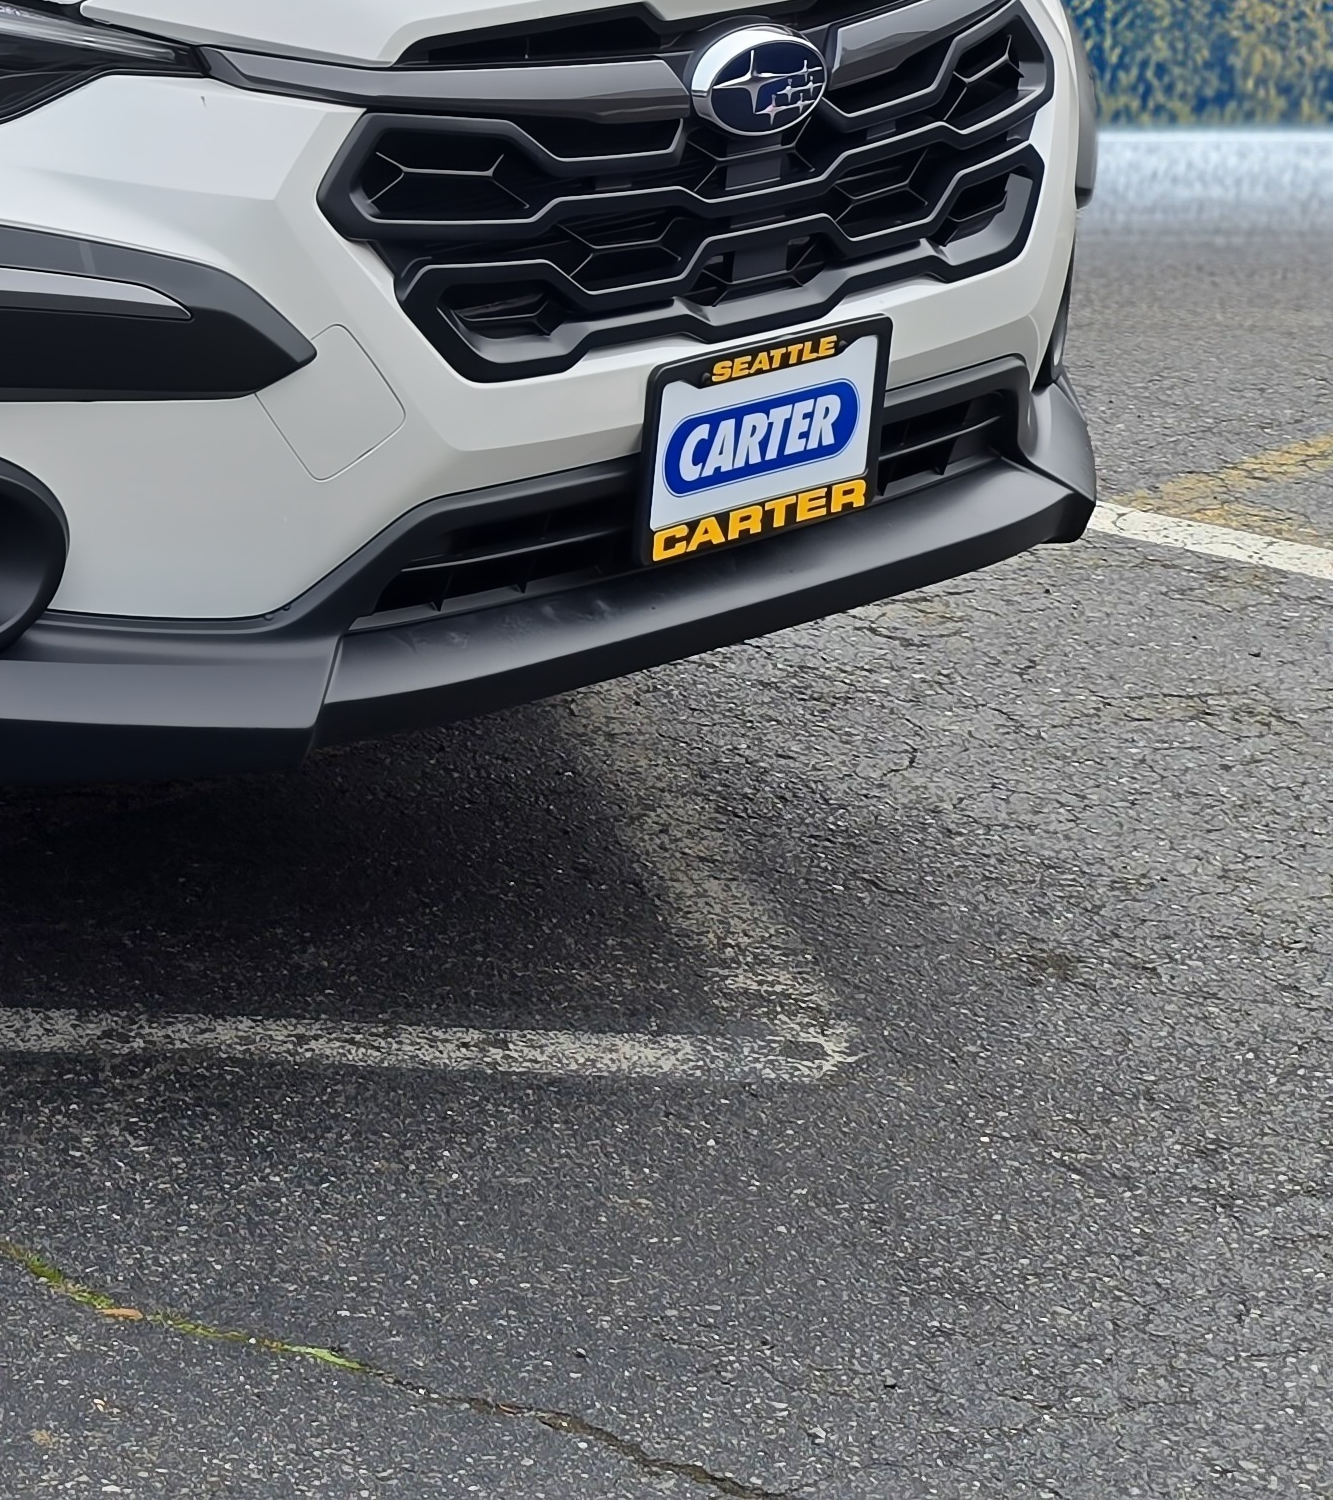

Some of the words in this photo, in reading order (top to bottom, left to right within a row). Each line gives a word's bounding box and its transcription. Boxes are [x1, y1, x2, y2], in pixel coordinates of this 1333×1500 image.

[711, 335, 838, 383] SEATTLE
[678, 393, 842, 482] CARTER
[652, 479, 867, 562] CARTER
